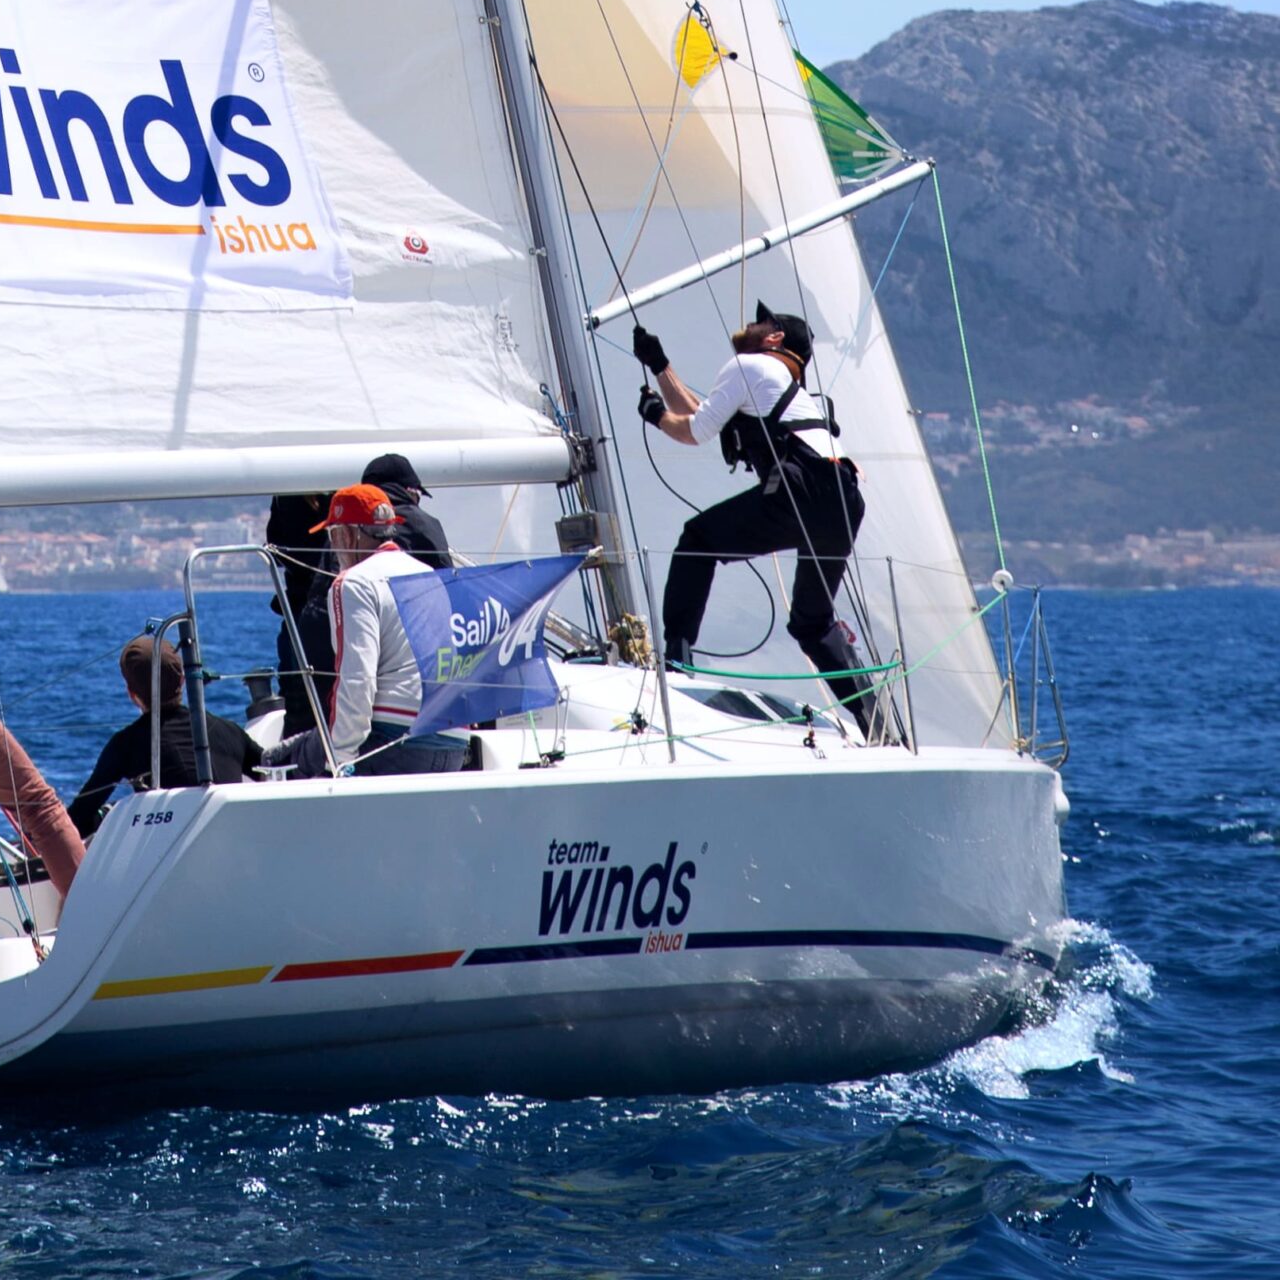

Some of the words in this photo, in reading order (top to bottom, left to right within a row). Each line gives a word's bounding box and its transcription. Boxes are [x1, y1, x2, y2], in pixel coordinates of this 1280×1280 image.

[210, 215, 318, 254] ishua
[450, 601, 490, 647] Sail
[131, 814, 141, 827] F
[144, 811, 173, 826] 258
[548, 838, 599, 865] team
[538, 841, 696, 936] winds
[644, 930, 683, 954] ishua
